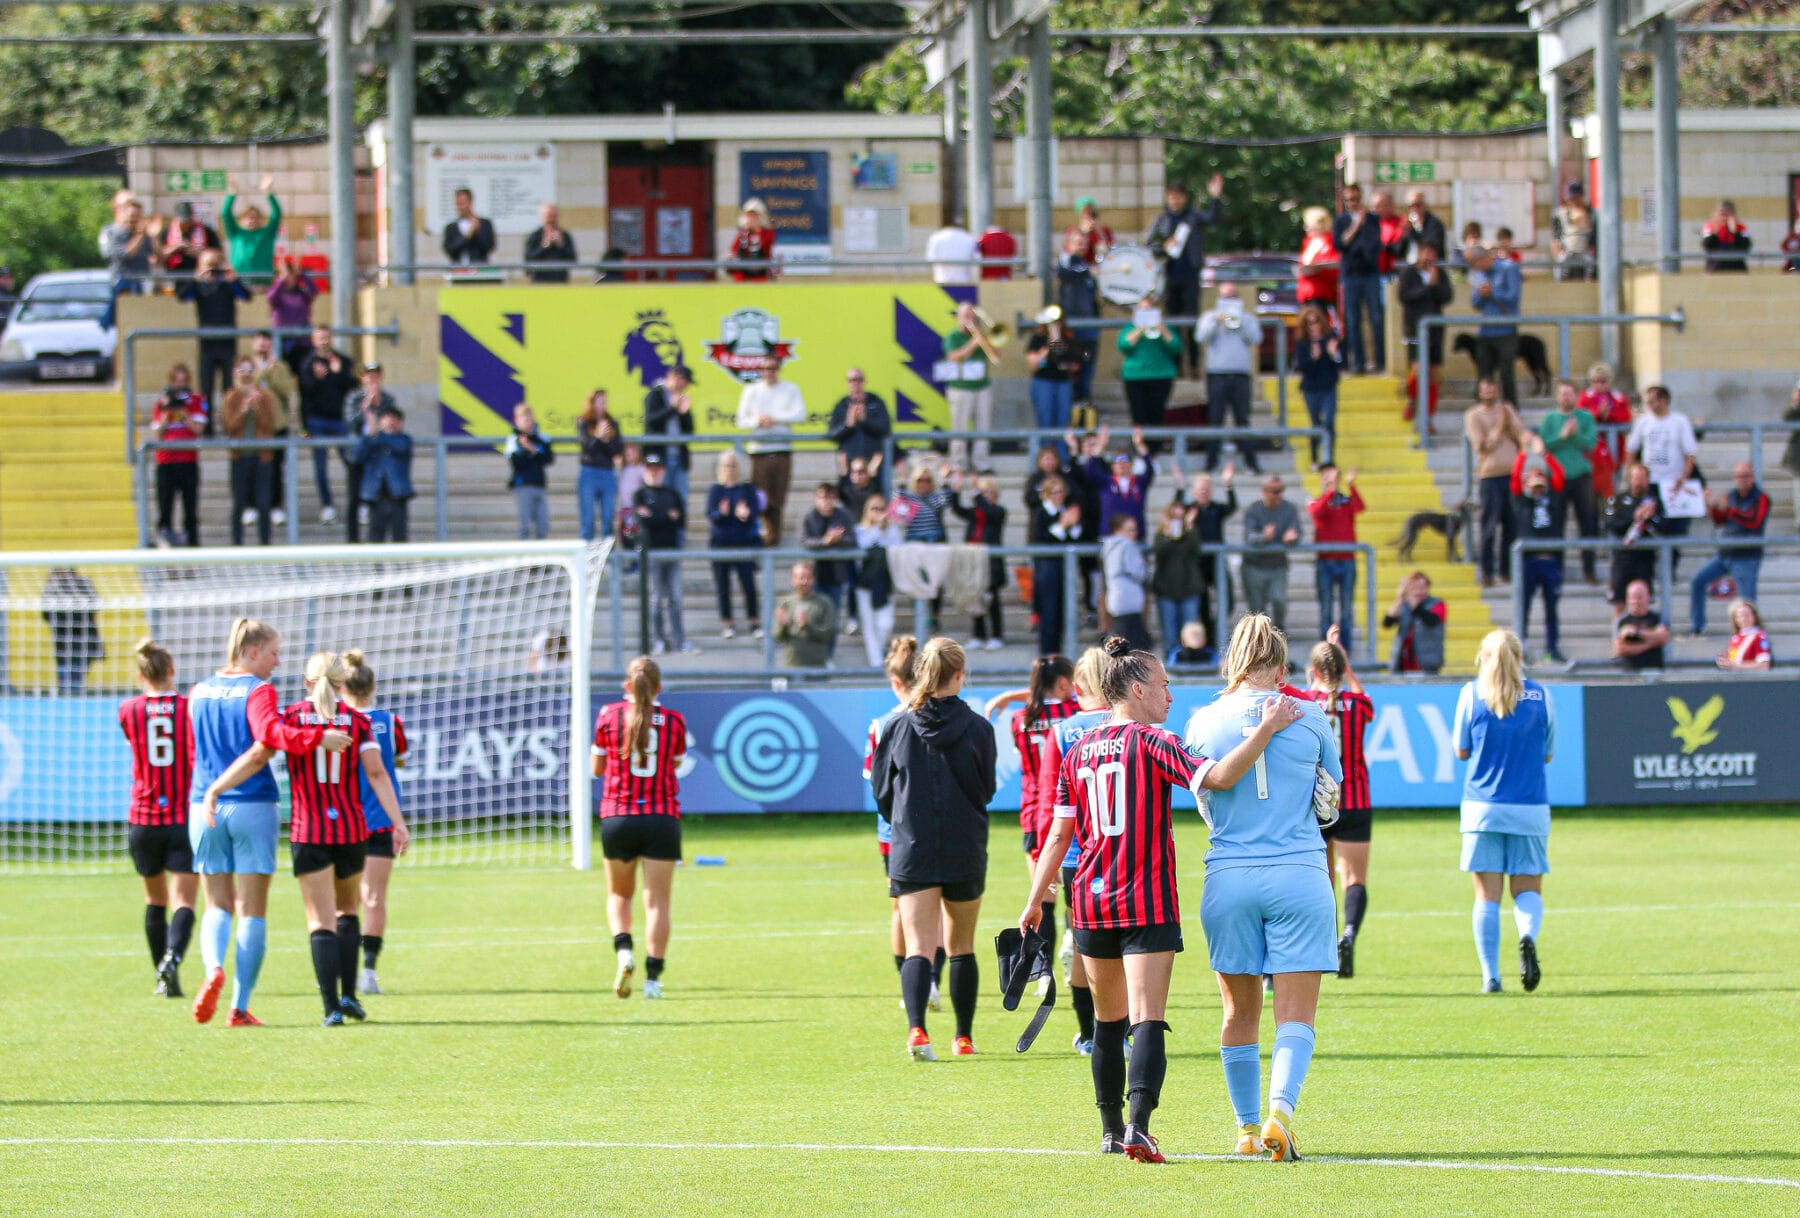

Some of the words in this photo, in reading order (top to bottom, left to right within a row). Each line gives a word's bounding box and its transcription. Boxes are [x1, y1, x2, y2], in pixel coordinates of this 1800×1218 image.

[147, 716, 174, 767] 6
[1081, 737, 1125, 761] STOBBS
[1077, 761, 1126, 841] 10
